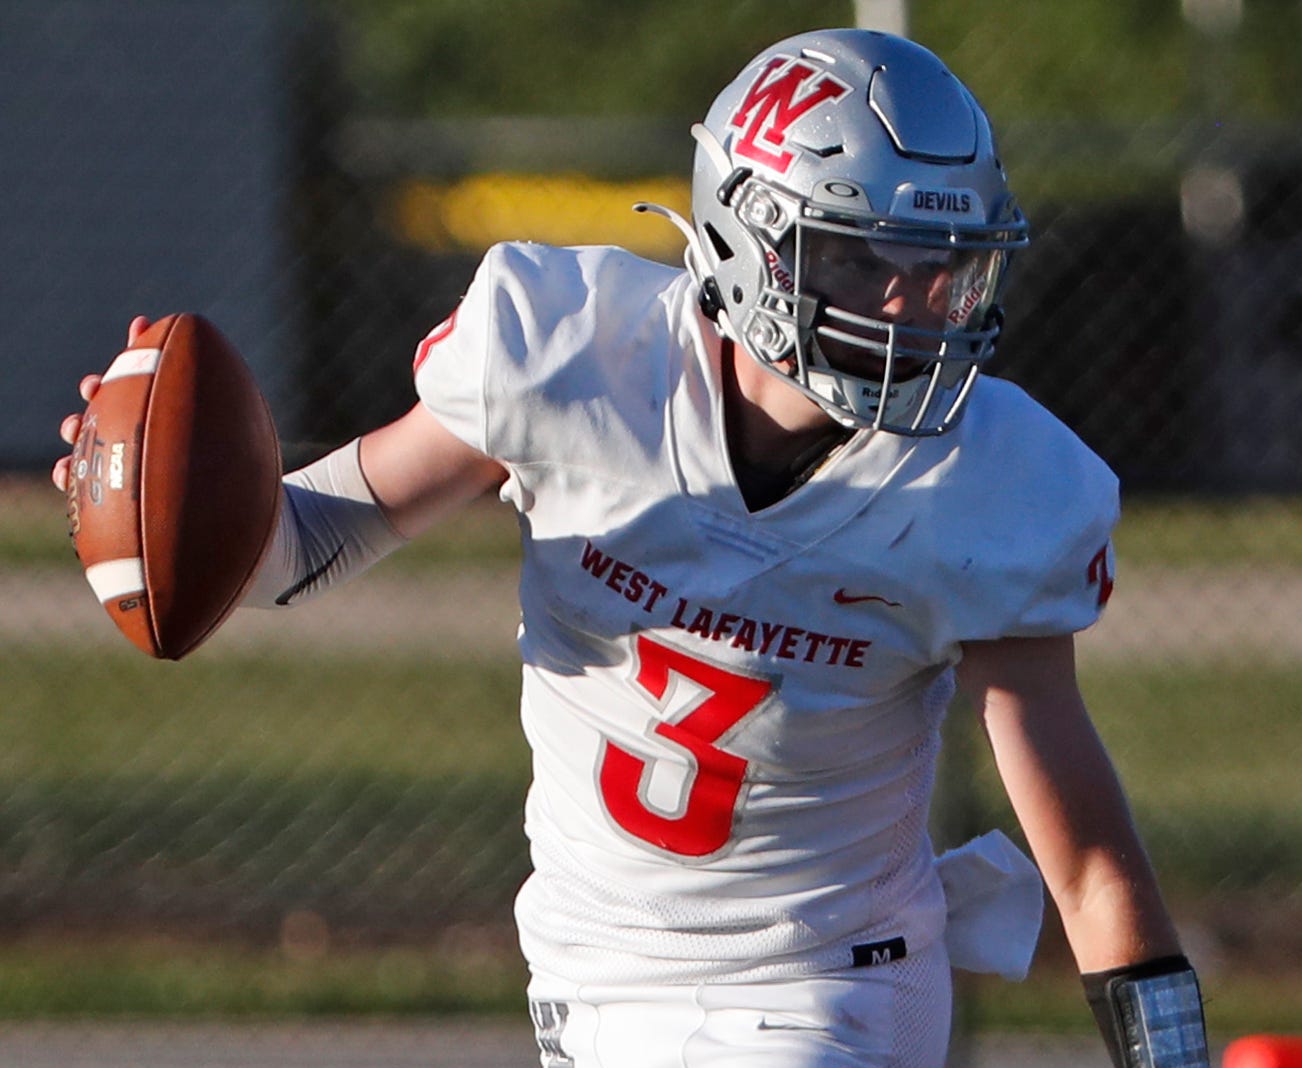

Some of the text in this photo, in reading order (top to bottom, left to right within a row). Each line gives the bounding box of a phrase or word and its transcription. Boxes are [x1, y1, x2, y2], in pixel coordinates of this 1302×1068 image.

[913, 190, 970, 212] DEVILS
[765, 249, 796, 294] Ridd
[948, 285, 982, 324] Ridd
[110, 442, 124, 489] NCAA
[580, 540, 872, 667] WEST LAFAYETTE
[595, 626, 779, 864] 3
[872, 948, 891, 966] M
